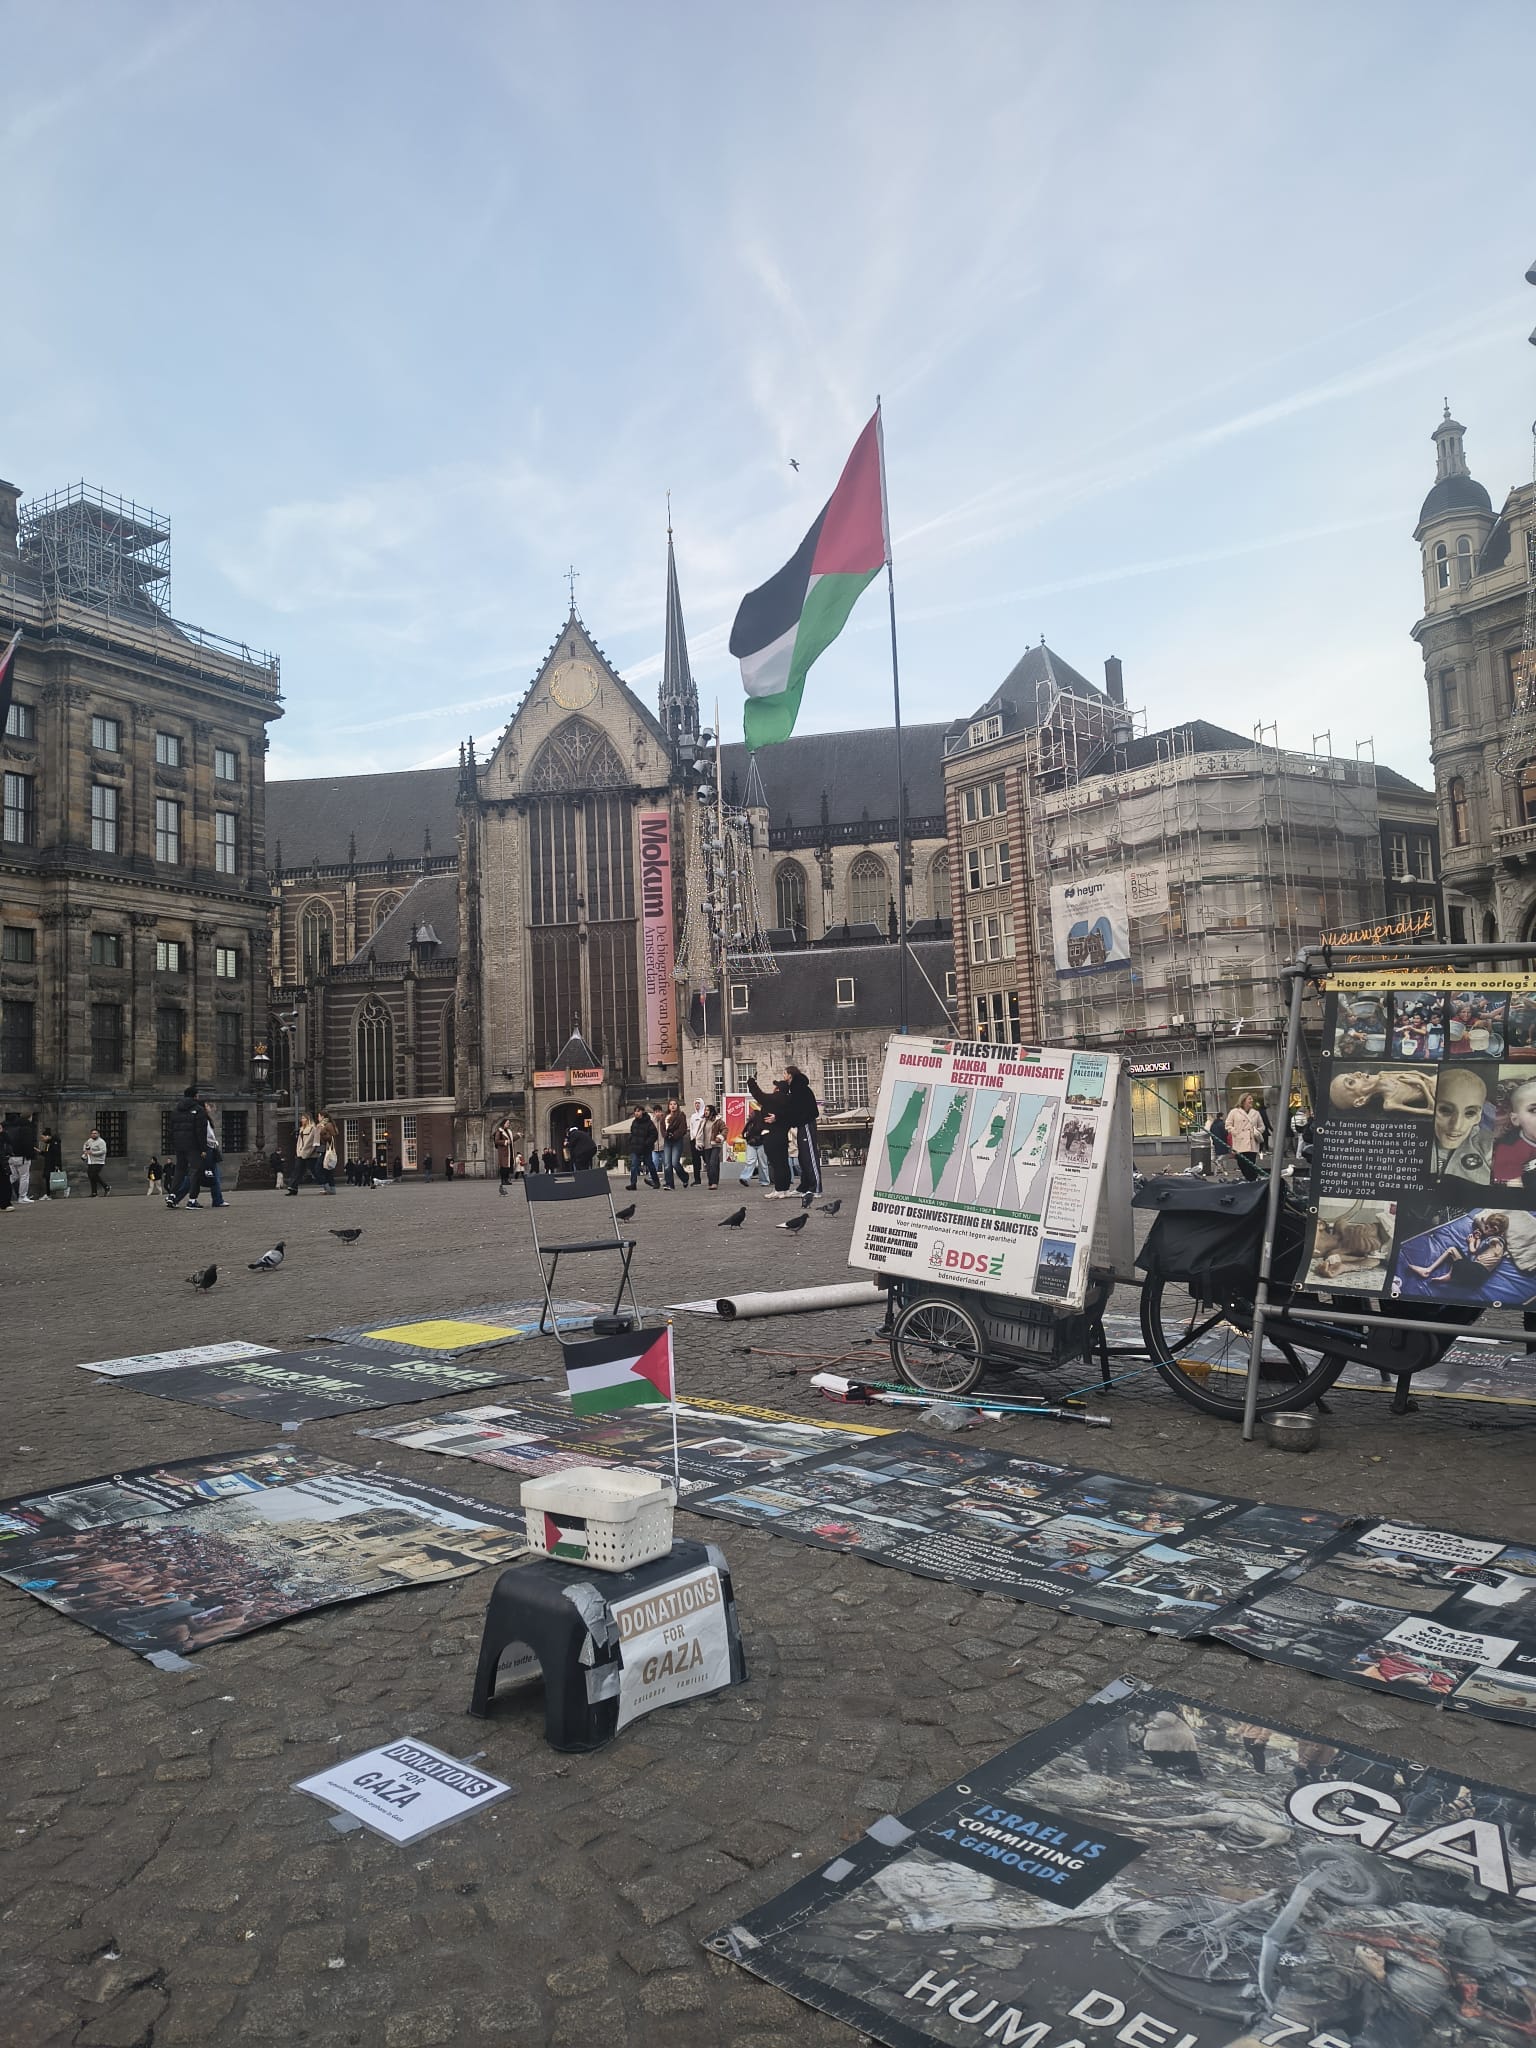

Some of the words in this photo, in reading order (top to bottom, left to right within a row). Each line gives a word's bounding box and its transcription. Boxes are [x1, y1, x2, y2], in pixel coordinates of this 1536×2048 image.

[641, 819, 668, 918] Mokum
[1077, 884, 1104, 897] heym
[656, 926, 667, 943] De
[1320, 911, 1434, 947] Nieuwendijk
[644, 926, 658, 995] Amsterdam
[654, 944, 669, 998] biografie
[1337, 979, 1377, 989] Honger
[1400, 980, 1438, 989] wapen
[1442, 979, 1452, 987] is
[1456, 980, 1477, 988] een
[1481, 979, 1529, 990] oorlogs
[659, 999, 669, 1019] van
[659, 1020, 671, 1055] Joods
[953, 1041, 1019, 1061] PALESTINE
[573, 1071, 599, 1079] Mokum
[899, 1053, 943, 1069] BALFOUR
[952, 1059, 987, 1073] NAKBA
[997, 1063, 1065, 1081] KOLONISATIE
[1130, 1062, 1170, 1073] SWAROVSKI
[951, 1072, 1004, 1089] BEZETTING
[1339, 1120, 1367, 1129] famine
[1370, 1123, 1417, 1131] aggravates
[1356, 1129, 1368, 1137] the
[1322, 1145, 1365, 1154] starvation
[1387, 1147, 1404, 1155] lack
[1348, 1138, 1400, 1147] Palestinians
[1321, 1162, 1363, 1170] continued
[1366, 1163, 1393, 1171] Israeli
[1322, 1153, 1363, 1161] treatment
[1377, 1155, 1396, 1164] light
[1399, 1156, 1408, 1164] of
[1319, 1178, 1348, 1186] people
[1379, 1181, 1401, 1189] Gaza
[1404, 1183, 1424, 1191] strip
[1341, 1171, 1372, 1179] against
[1375, 1172, 1417, 1181] displaced
[1336, 1186, 1352, 1195] July
[871, 1201, 906, 1217] BOYCOT
[906, 1206, 980, 1228] DESINVESTERING
[981, 1218, 993, 1230] EN
[993, 1220, 1039, 1238] SANCTIES
[888, 1227, 918, 1240] BEZETTING
[896, 1219, 911, 1228] Voor
[911, 1220, 951, 1234] internationaal
[952, 1228, 969, 1237] recht
[969, 1230, 986, 1241] tegen
[987, 1233, 1017, 1245] apartheid
[887, 1236, 918, 1249] APARTHEID
[868, 1252, 887, 1263] TERUG
[945, 1249, 988, 1273] BDS
[988, 1253, 1005, 1276] NL
[938, 1272, 986, 1287] bdsnederland.nl
[390, 1360, 508, 1384] ISRAEL
[931, 1543, 973, 1559] SCHOLEN
[966, 1540, 1015, 1555] WONINGEN
[621, 1579, 716, 1637] DONATIONS
[662, 1624, 685, 1645] FOR
[1418, 1630, 1449, 1644] WAR
[1427, 1626, 1485, 1645] GAZA
[1436, 1643, 1484, 1654] KILLED
[642, 1637, 704, 1685] GAZA
[391, 1745, 489, 1797] DONATIONS
[398, 1771, 427, 1787] FOR
[352, 1771, 422, 1809] GAZA
[974, 1804, 1069, 1846] ISRAEL
[1071, 1839, 1108, 1859] IS
[958, 1817, 1086, 1871] COMMITTING
[1289, 1780, 1536, 1902] GA
[936, 1828, 957, 1841] A
[959, 1836, 1072, 1886] GENOCIDE
[903, 1969, 1087, 2048] HUM
